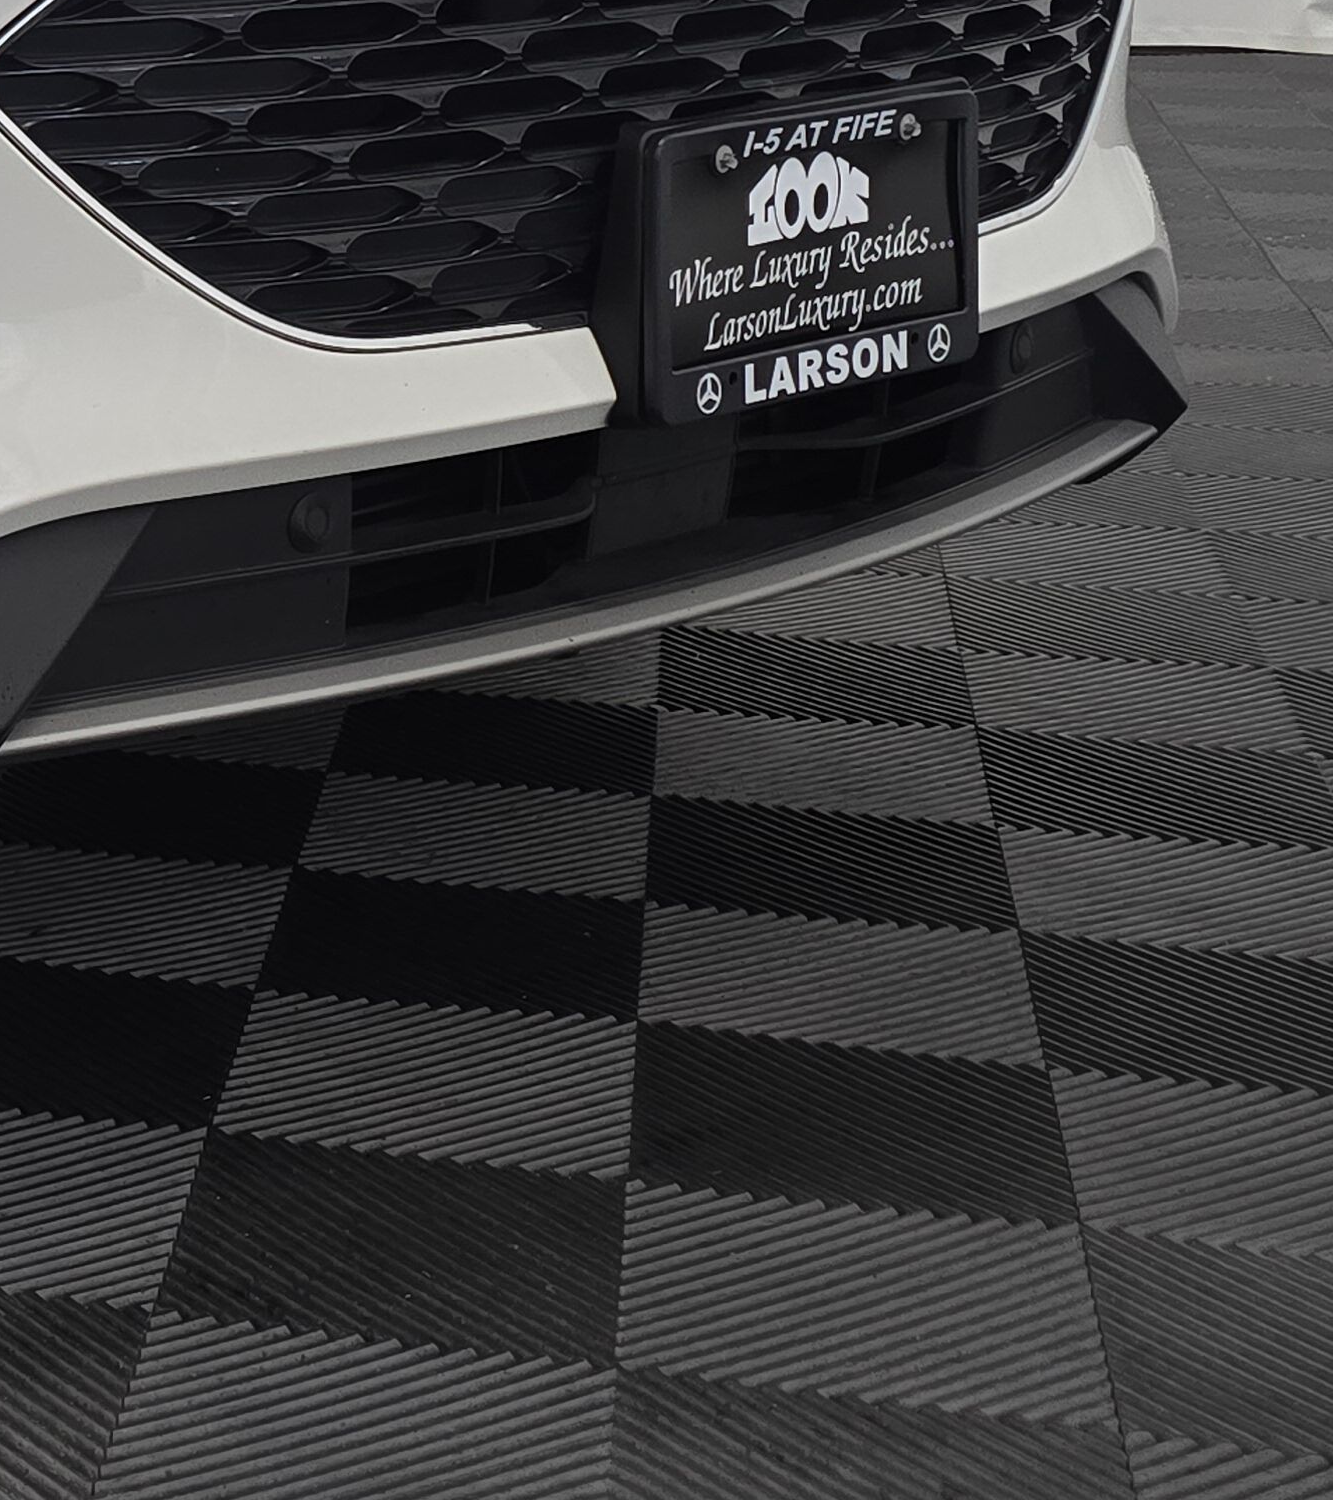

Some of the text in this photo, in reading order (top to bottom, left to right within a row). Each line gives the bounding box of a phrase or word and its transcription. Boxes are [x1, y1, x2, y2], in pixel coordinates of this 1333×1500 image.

[742, 109, 898, 159] I-5 AT FIFE
[747, 150, 870, 247] LOOK
[669, 256, 744, 307] Where
[749, 241, 833, 290] Luxury
[703, 274, 924, 352] LarsonLuxury.com
[744, 330, 909, 405] LARSON
